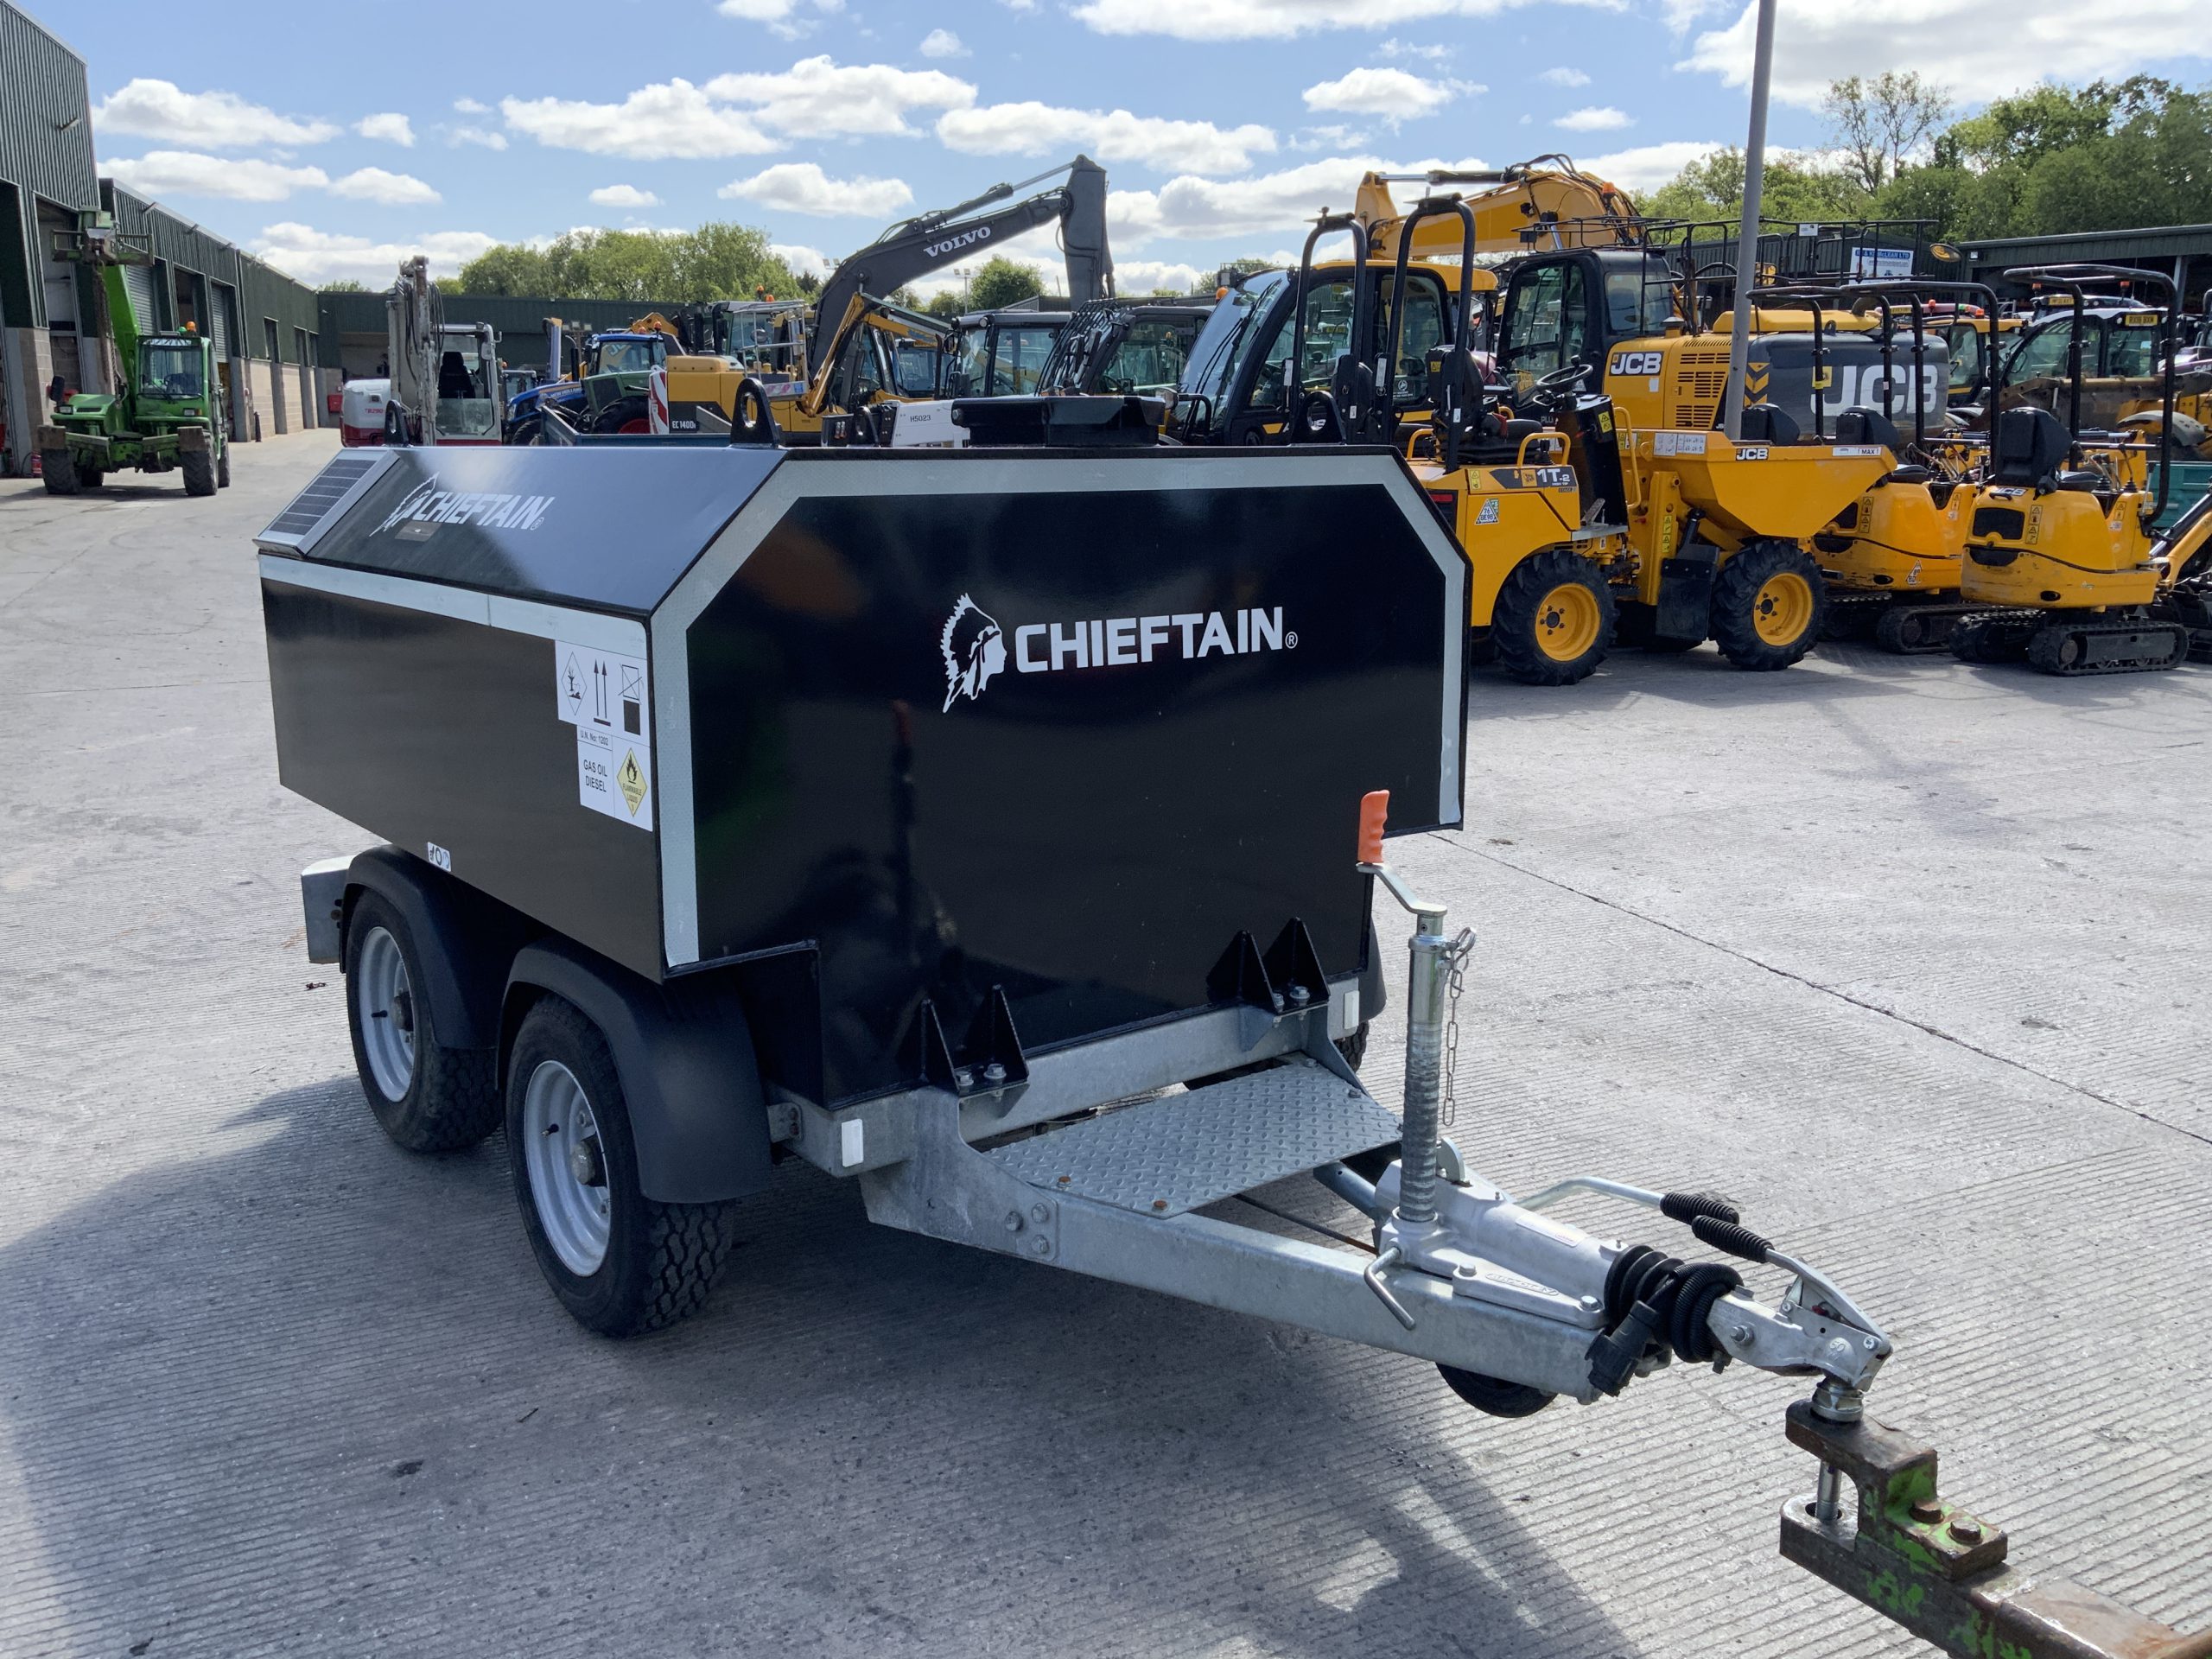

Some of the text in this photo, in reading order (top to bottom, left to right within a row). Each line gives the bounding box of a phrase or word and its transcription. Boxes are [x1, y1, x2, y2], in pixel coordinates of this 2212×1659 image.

[923, 226, 991, 257] VOLVO
[1611, 353, 1662, 374] JCB
[1810, 365, 1938, 416] JCB
[1736, 448, 1768, 461] JCB
[1993, 487, 2025, 496] JCB
[598, 735, 609, 746] 1202
[583, 759, 608, 777] GAS OIL
[585, 775, 607, 792] DIESEL
[1829, 1339, 1847, 1353] 50
